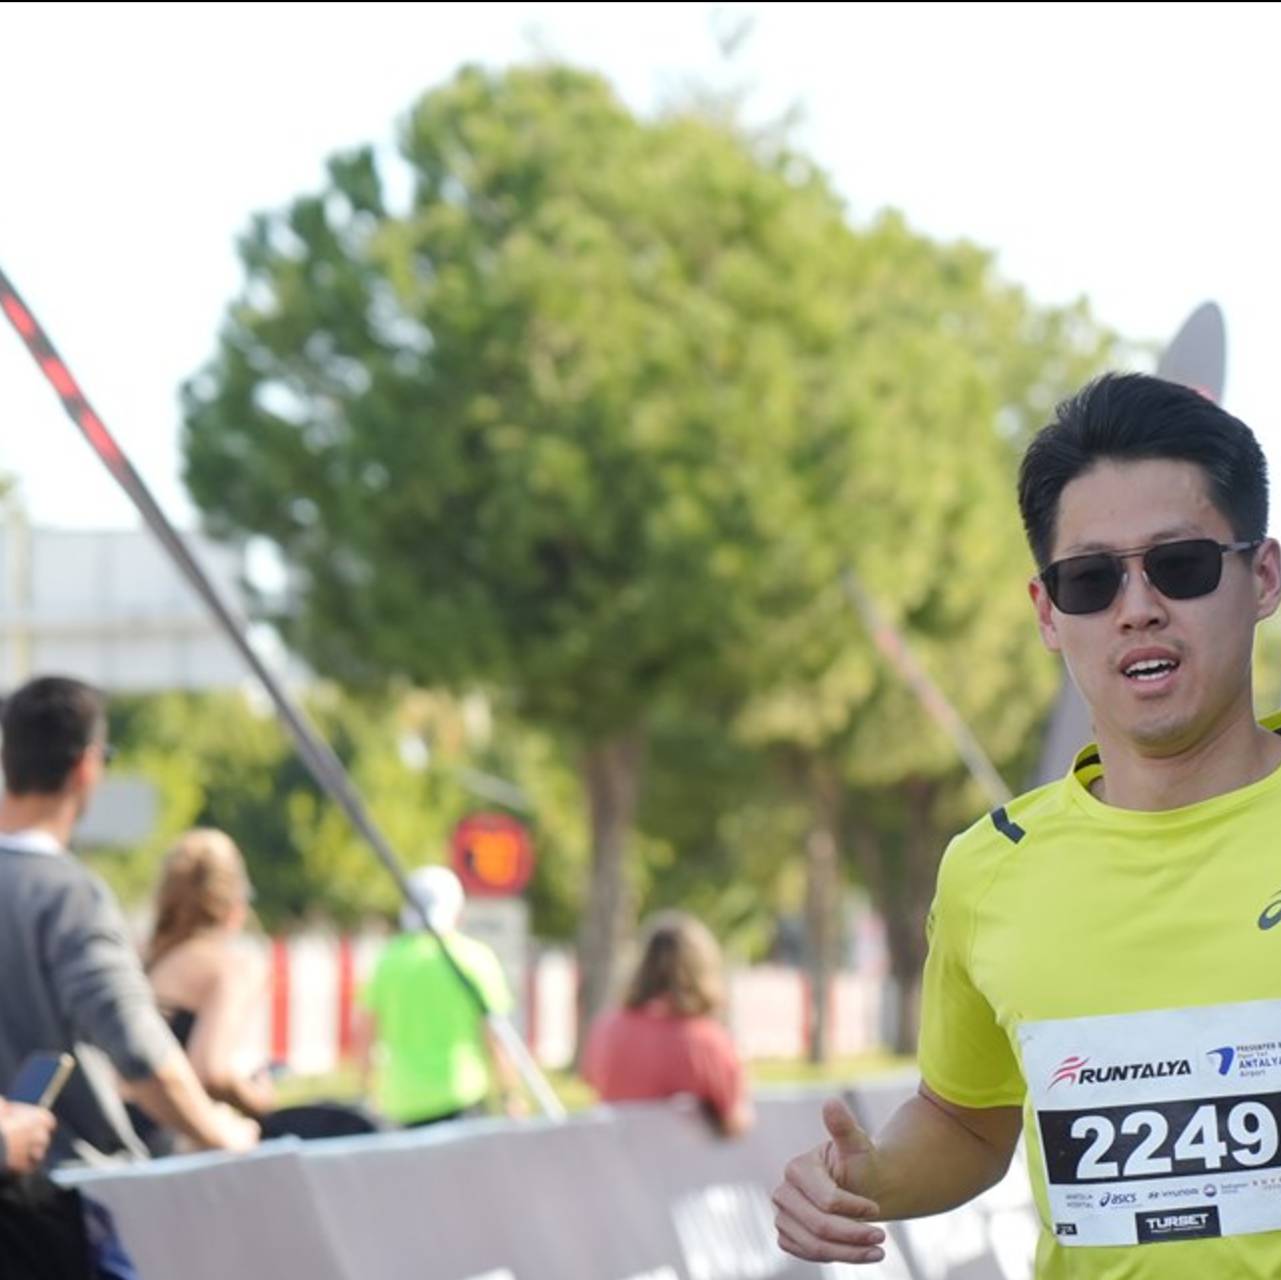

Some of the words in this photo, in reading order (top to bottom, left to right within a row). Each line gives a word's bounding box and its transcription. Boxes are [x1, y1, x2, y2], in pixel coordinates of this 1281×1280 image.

[1078, 1059, 1192, 1085] RUNTALYA
[1070, 1101, 1280, 1180] 2249
[1145, 1213, 1210, 1229] TURSET
